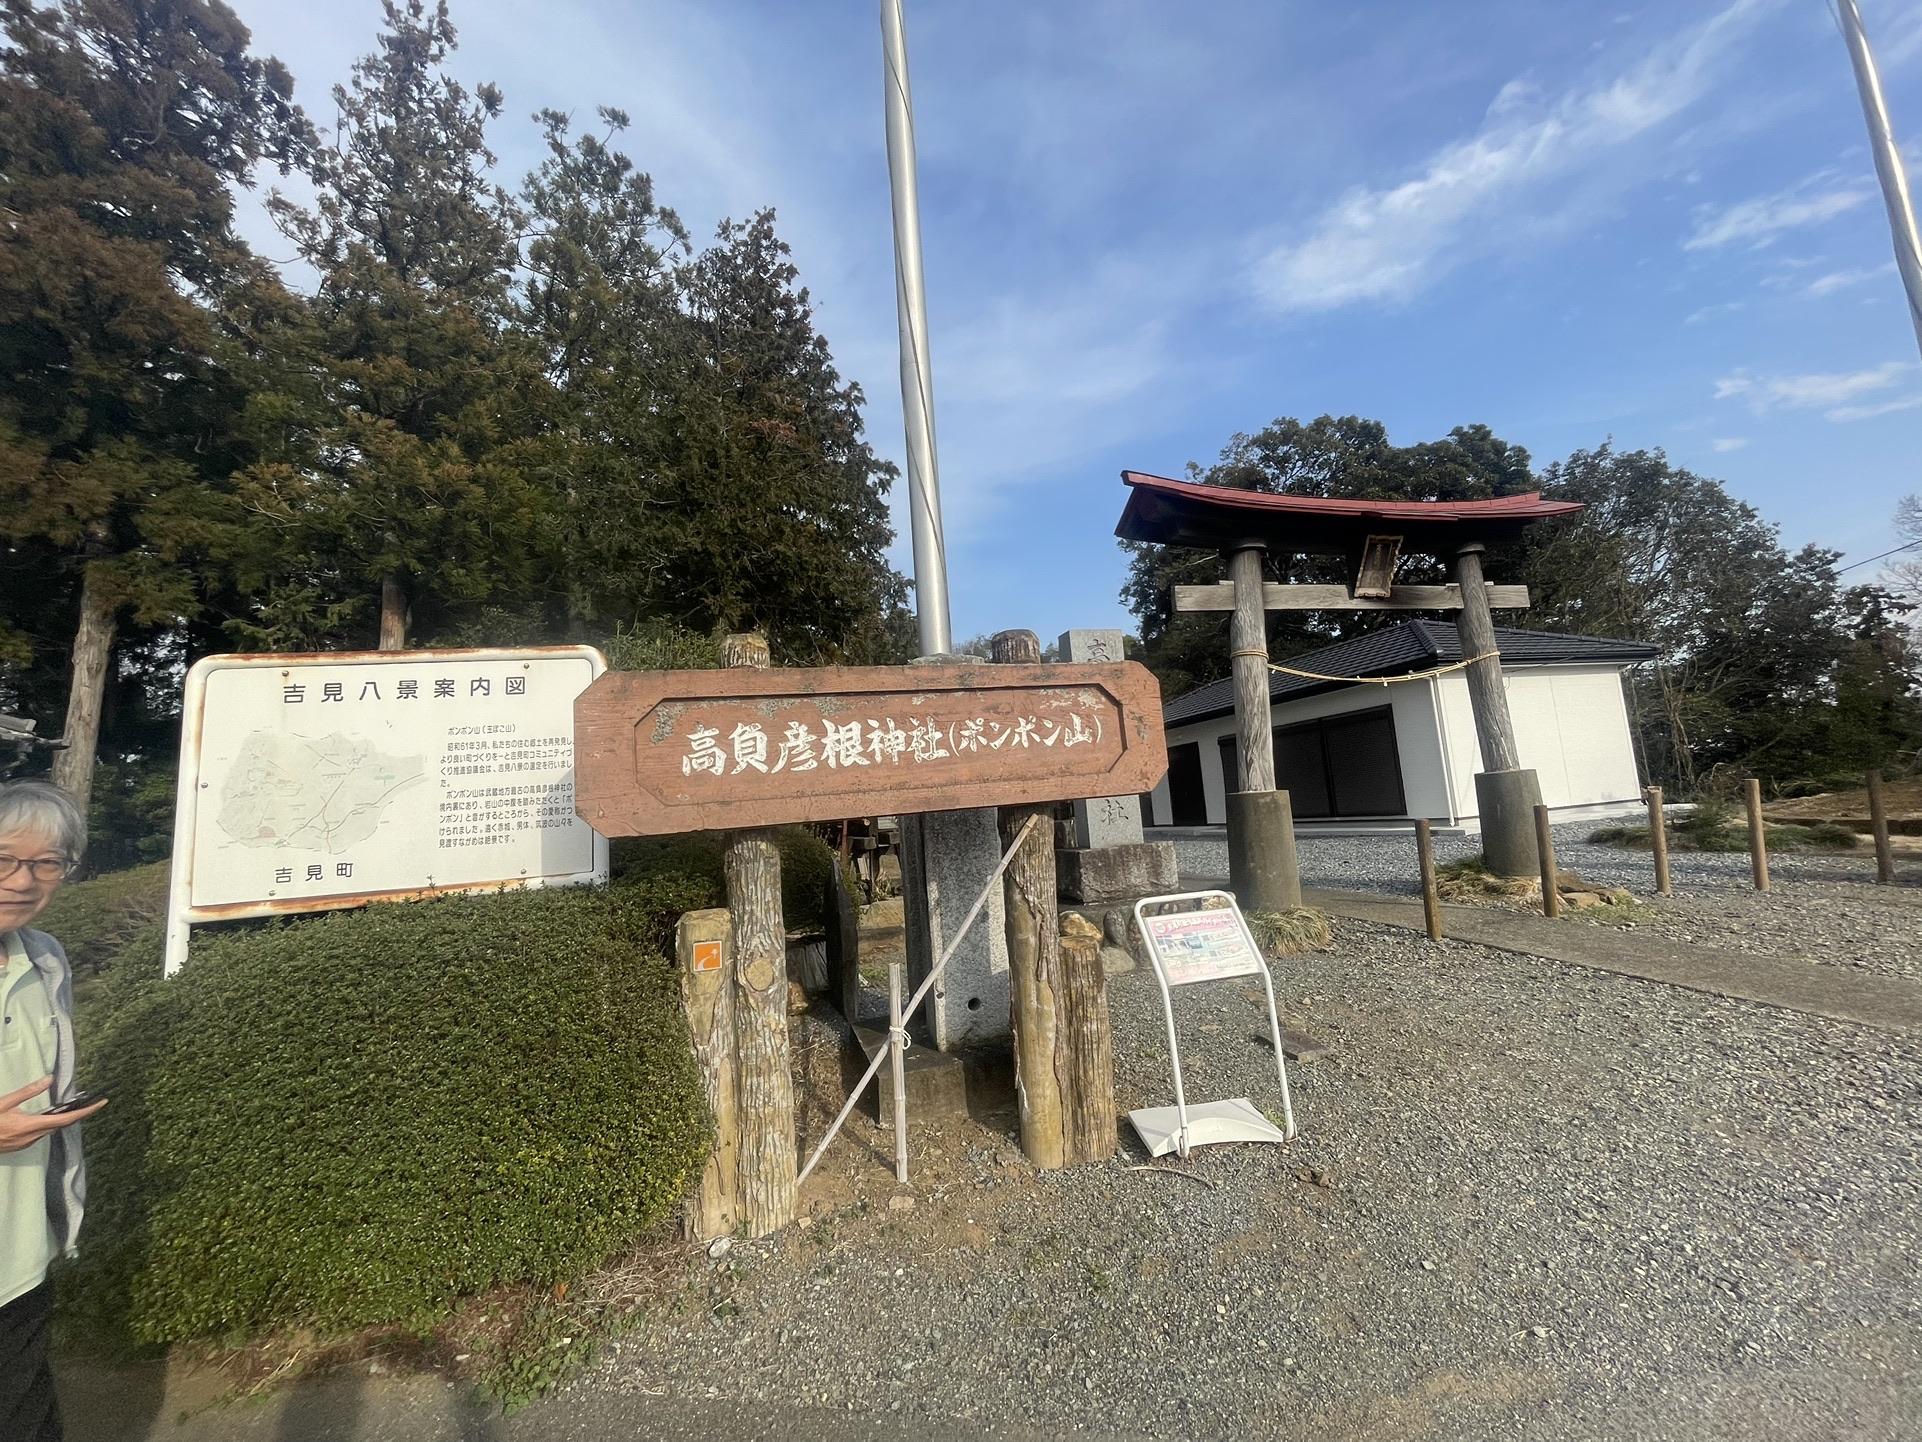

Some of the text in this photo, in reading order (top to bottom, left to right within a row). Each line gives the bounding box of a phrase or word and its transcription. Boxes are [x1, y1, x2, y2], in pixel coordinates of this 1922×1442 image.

[283, 676, 526, 704] 吉見八景案内図
[274, 862, 354, 884] 吉見町
